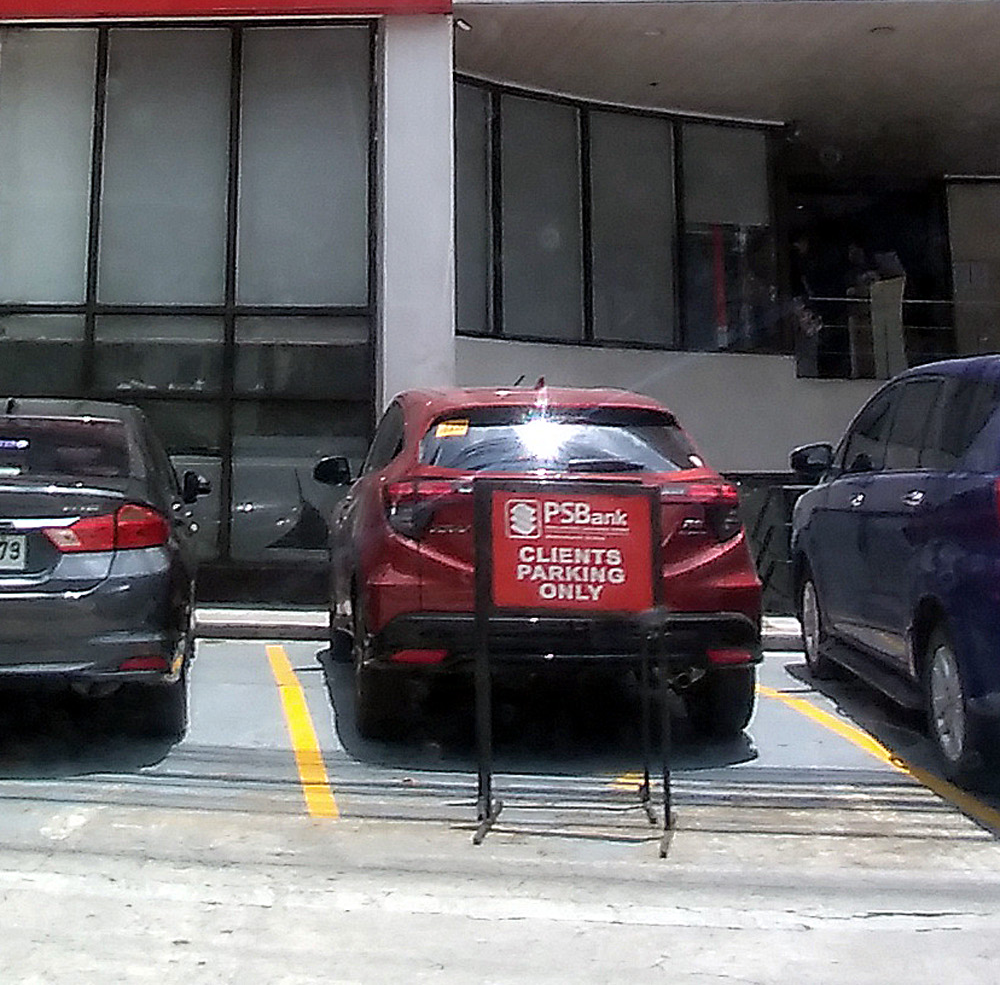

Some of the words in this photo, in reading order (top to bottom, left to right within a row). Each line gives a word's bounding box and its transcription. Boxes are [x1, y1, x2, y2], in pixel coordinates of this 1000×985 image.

[543, 501, 628, 526] PSBank
[519, 546, 622, 565] CLIENTS
[516, 565, 626, 584] PARKING
[538, 583, 604, 601] ONLY
